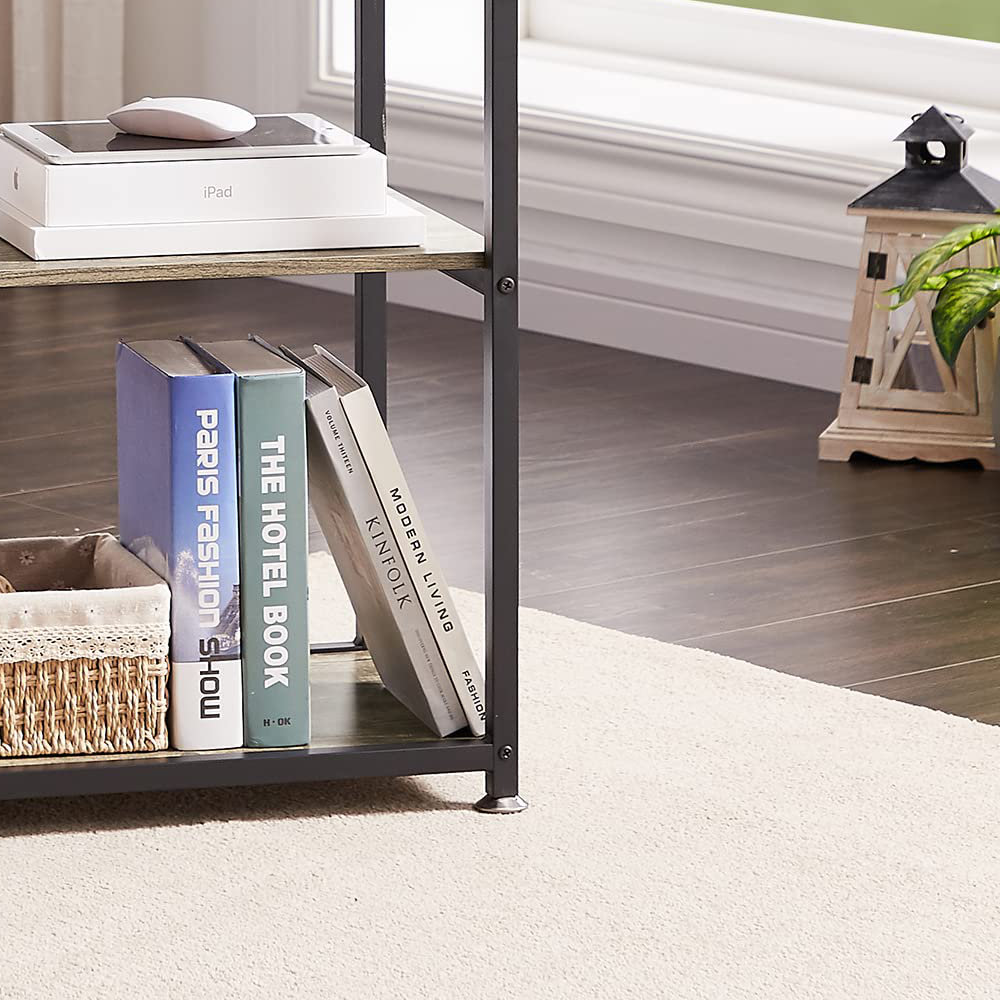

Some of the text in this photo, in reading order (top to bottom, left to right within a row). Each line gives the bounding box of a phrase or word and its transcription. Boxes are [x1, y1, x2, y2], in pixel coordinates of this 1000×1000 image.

[203, 185, 232, 199] iPad
[324, 409, 341, 441] VOLUME
[260, 435, 289, 689] THE HOTEL BOOK
[365, 515, 412, 610] KINFOLK
[389, 487, 427, 565] MODERN
[423, 572, 454, 633] LIVING
[199, 637, 220, 719] SHOW
[462, 670, 487, 721] FASHION
